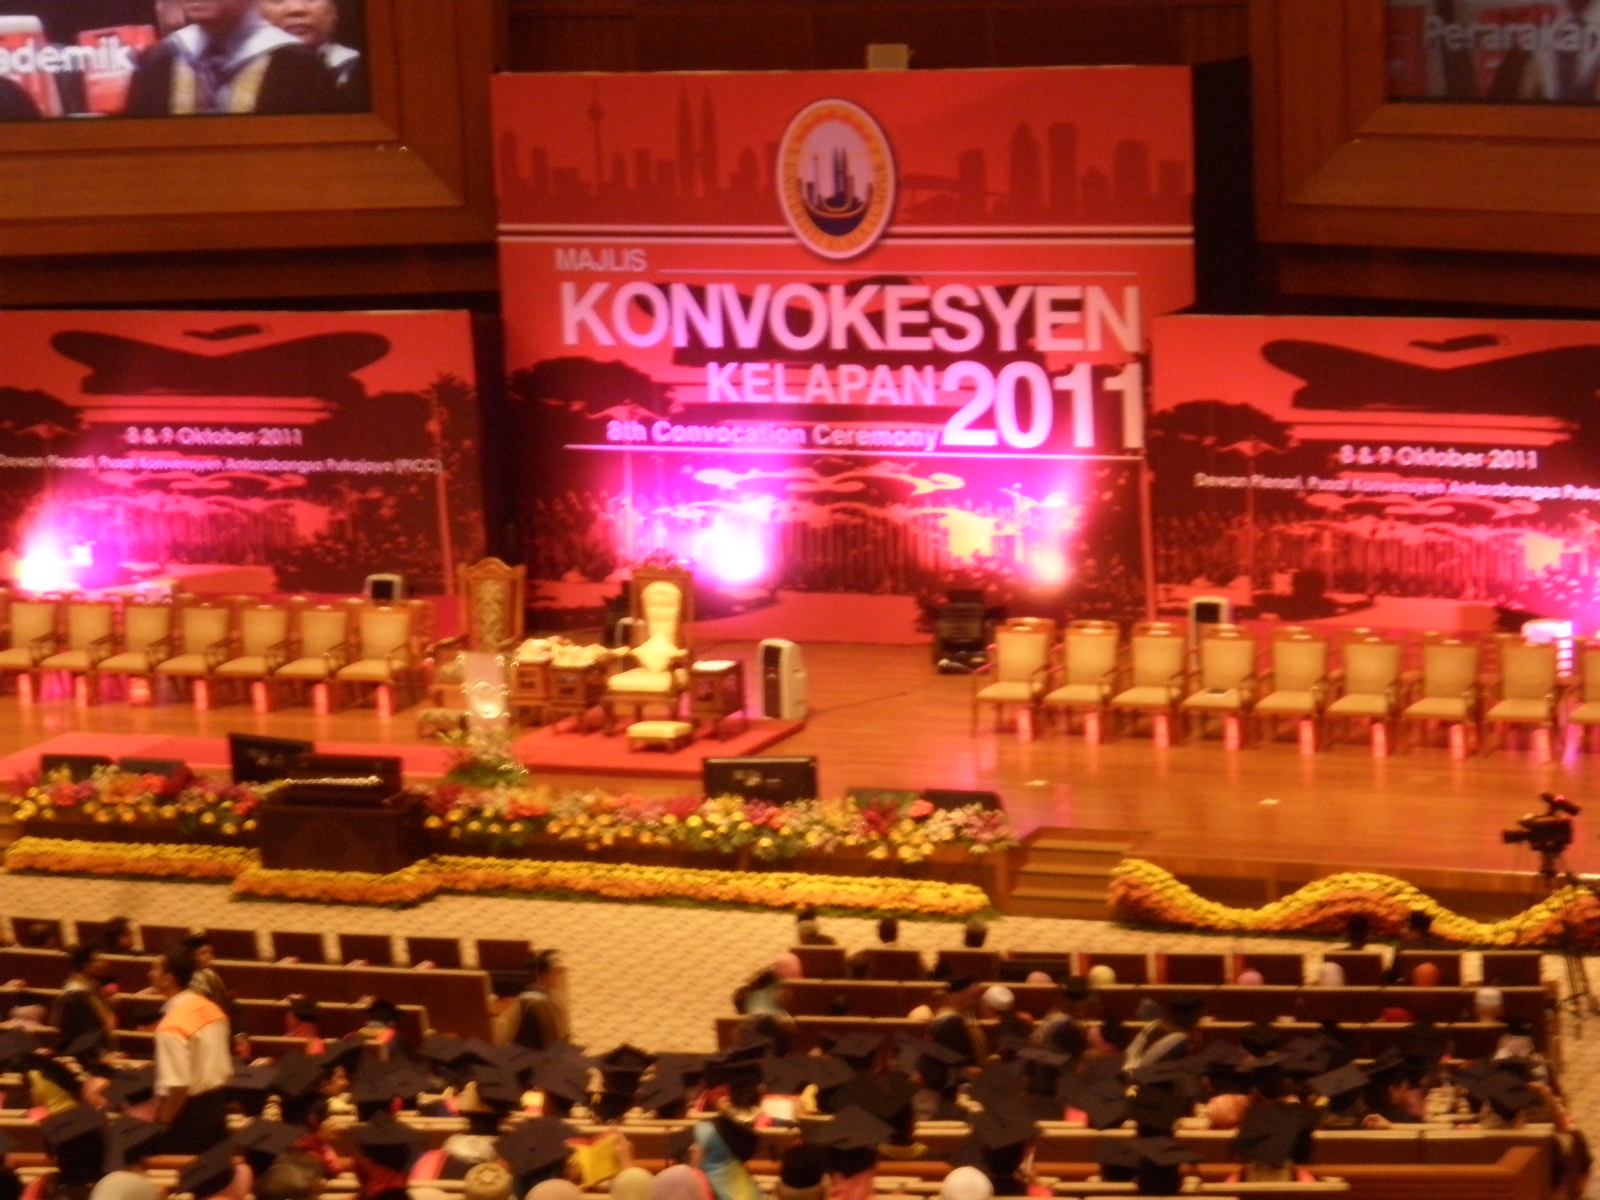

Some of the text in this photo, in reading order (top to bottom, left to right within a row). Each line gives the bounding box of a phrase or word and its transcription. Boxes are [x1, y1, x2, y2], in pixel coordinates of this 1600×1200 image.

[554, 248, 648, 273] MAJLIS
[560, 280, 1141, 352] KONVOKESYEN
[706, 360, 1145, 449] KELAPAN 2011
[125, 426, 140, 445] 8
[160, 426, 174, 445] 9
[175, 426, 255, 446] Oktober
[258, 427, 303, 446] 2011
[607, 420, 939, 452] 8th Convocation Ceremony
[1339, 444, 1355, 464] 8
[1378, 445, 1393, 465] 9
[1397, 446, 1485, 468] Oktober
[1487, 448, 1538, 470] 2011
